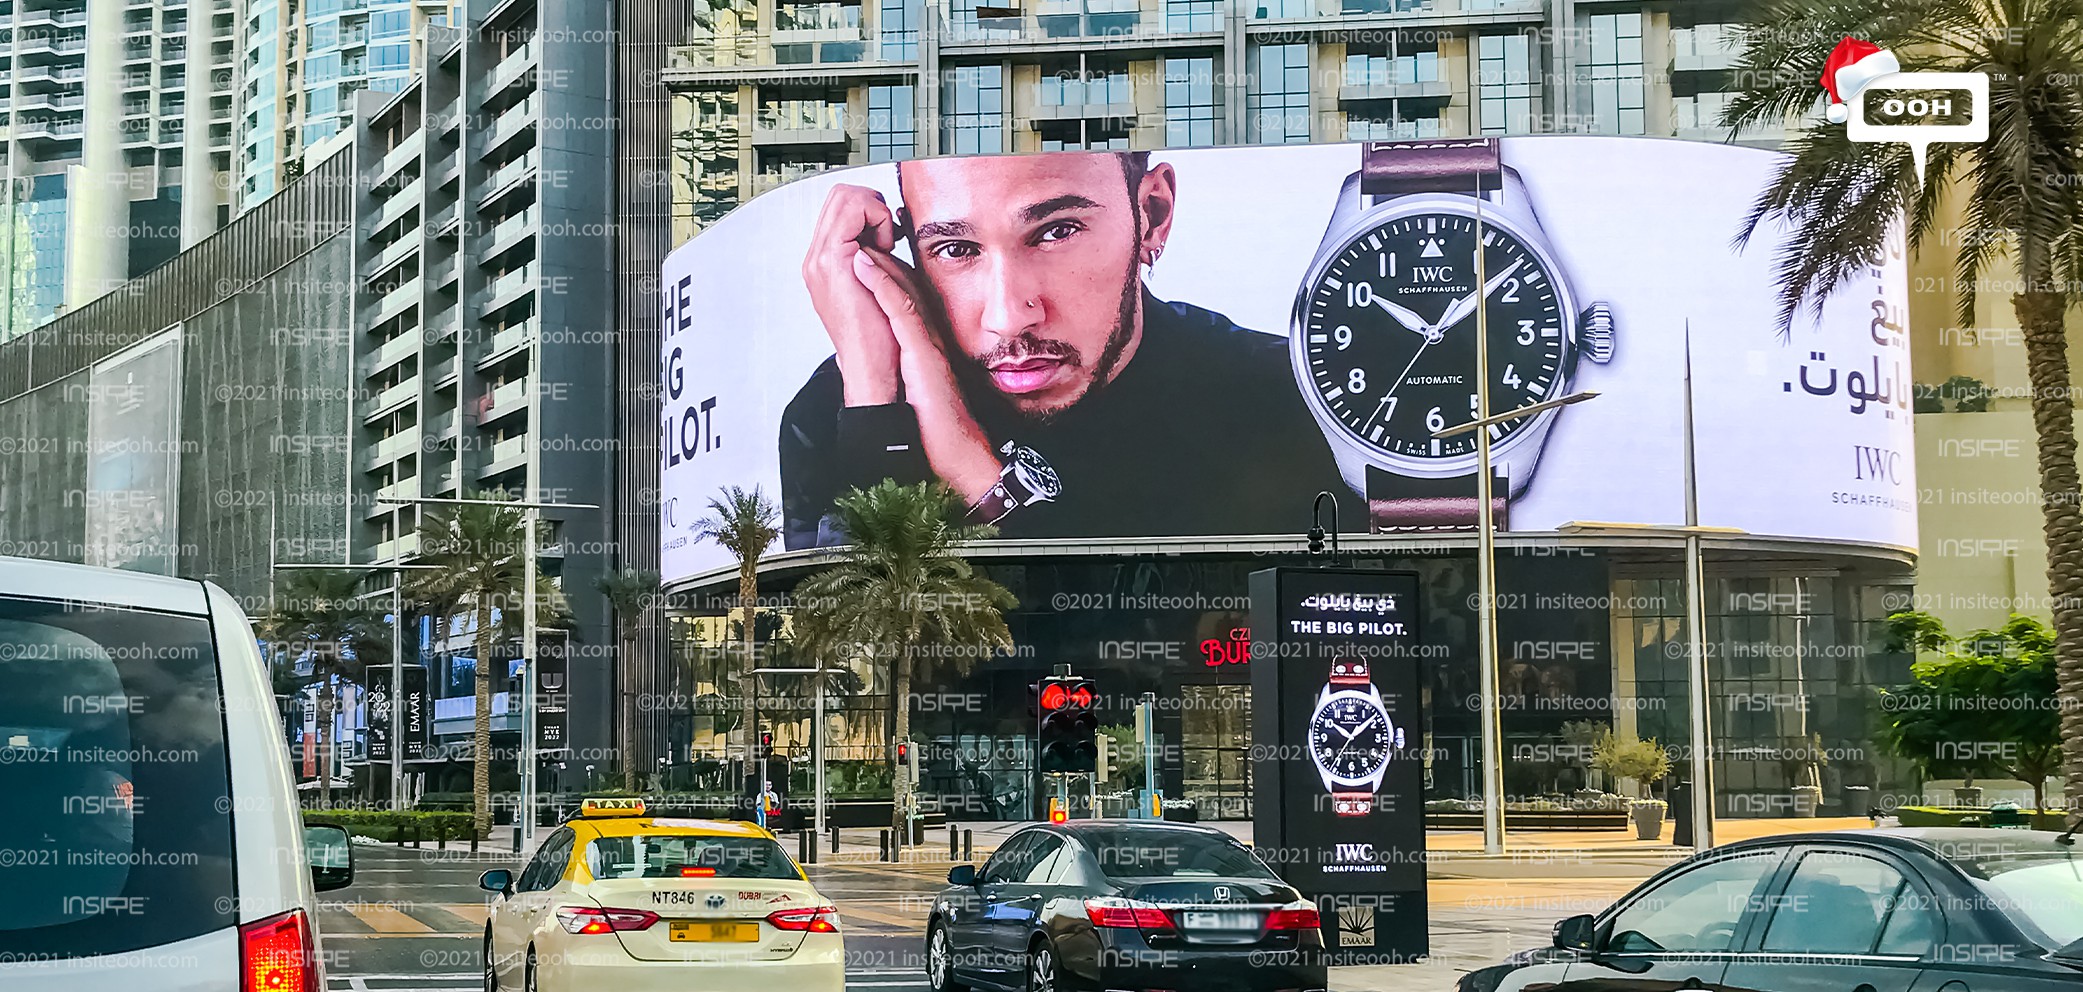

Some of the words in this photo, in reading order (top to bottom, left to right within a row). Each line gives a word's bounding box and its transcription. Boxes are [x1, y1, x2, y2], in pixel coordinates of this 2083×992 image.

[1379, 252, 1396, 277] 11
[1412, 266, 1453, 283] IWC
[1347, 282, 1372, 307] 10
[1398, 285, 1468, 294] SCHAFFHAUSEN
[1501, 278, 1520, 303] 2
[1334, 325, 1352, 350] 9
[1516, 320, 1535, 345] 3
[1348, 368, 1366, 393] 8
[1406, 375, 1463, 385] AUTOMATIC
[1502, 364, 1522, 389] 4
[1380, 397, 1398, 421] 7
[1426, 407, 1444, 432] 6
[1854, 445, 1902, 486] IWC
[1291, 620, 1321, 634] THE
[1327, 621, 1354, 635] BIG
[1359, 622, 1408, 636] PILOT.
[410, 691, 420, 732] EMAAR
[1344, 714, 1358, 722] IWC
[594, 799, 636, 809] TAXI
[1335, 843, 1373, 861] IWC
[1322, 865, 1387, 873] SCHAFFHAUSEN
[651, 890, 696, 905] NT846
[1341, 936, 1372, 945] EMAAR
